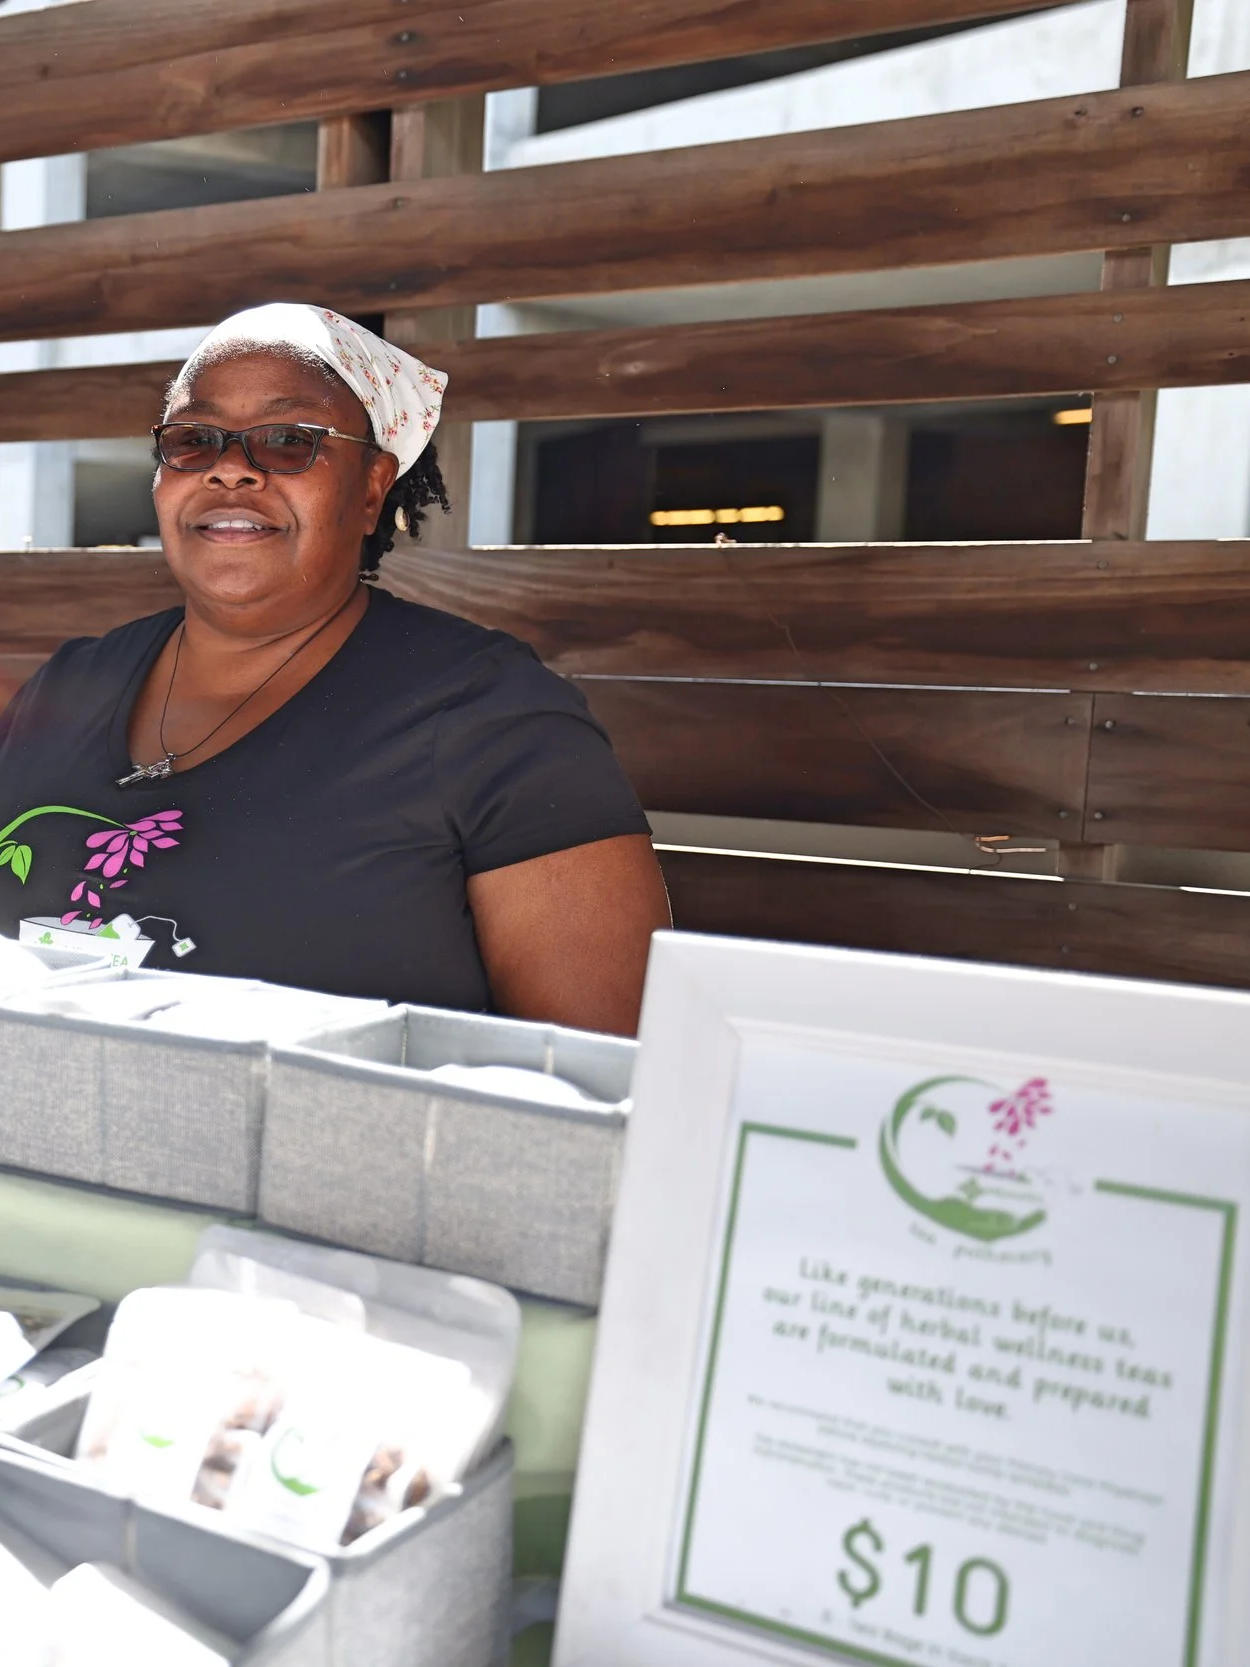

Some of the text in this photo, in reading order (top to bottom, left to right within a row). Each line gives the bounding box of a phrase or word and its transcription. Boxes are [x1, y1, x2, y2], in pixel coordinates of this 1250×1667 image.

[111, 953, 128, 967] EA
[762, 1287, 1173, 1390] our line of herbal wellness teas
[800, 1255, 847, 1286] Like
[857, 1274, 1000, 1319] generations
[1011, 1298, 1086, 1336] before
[772, 1320, 1150, 1420] are formulated and prepared
[886, 1375, 944, 1405] with
[836, 1516, 1010, 1638] $10
